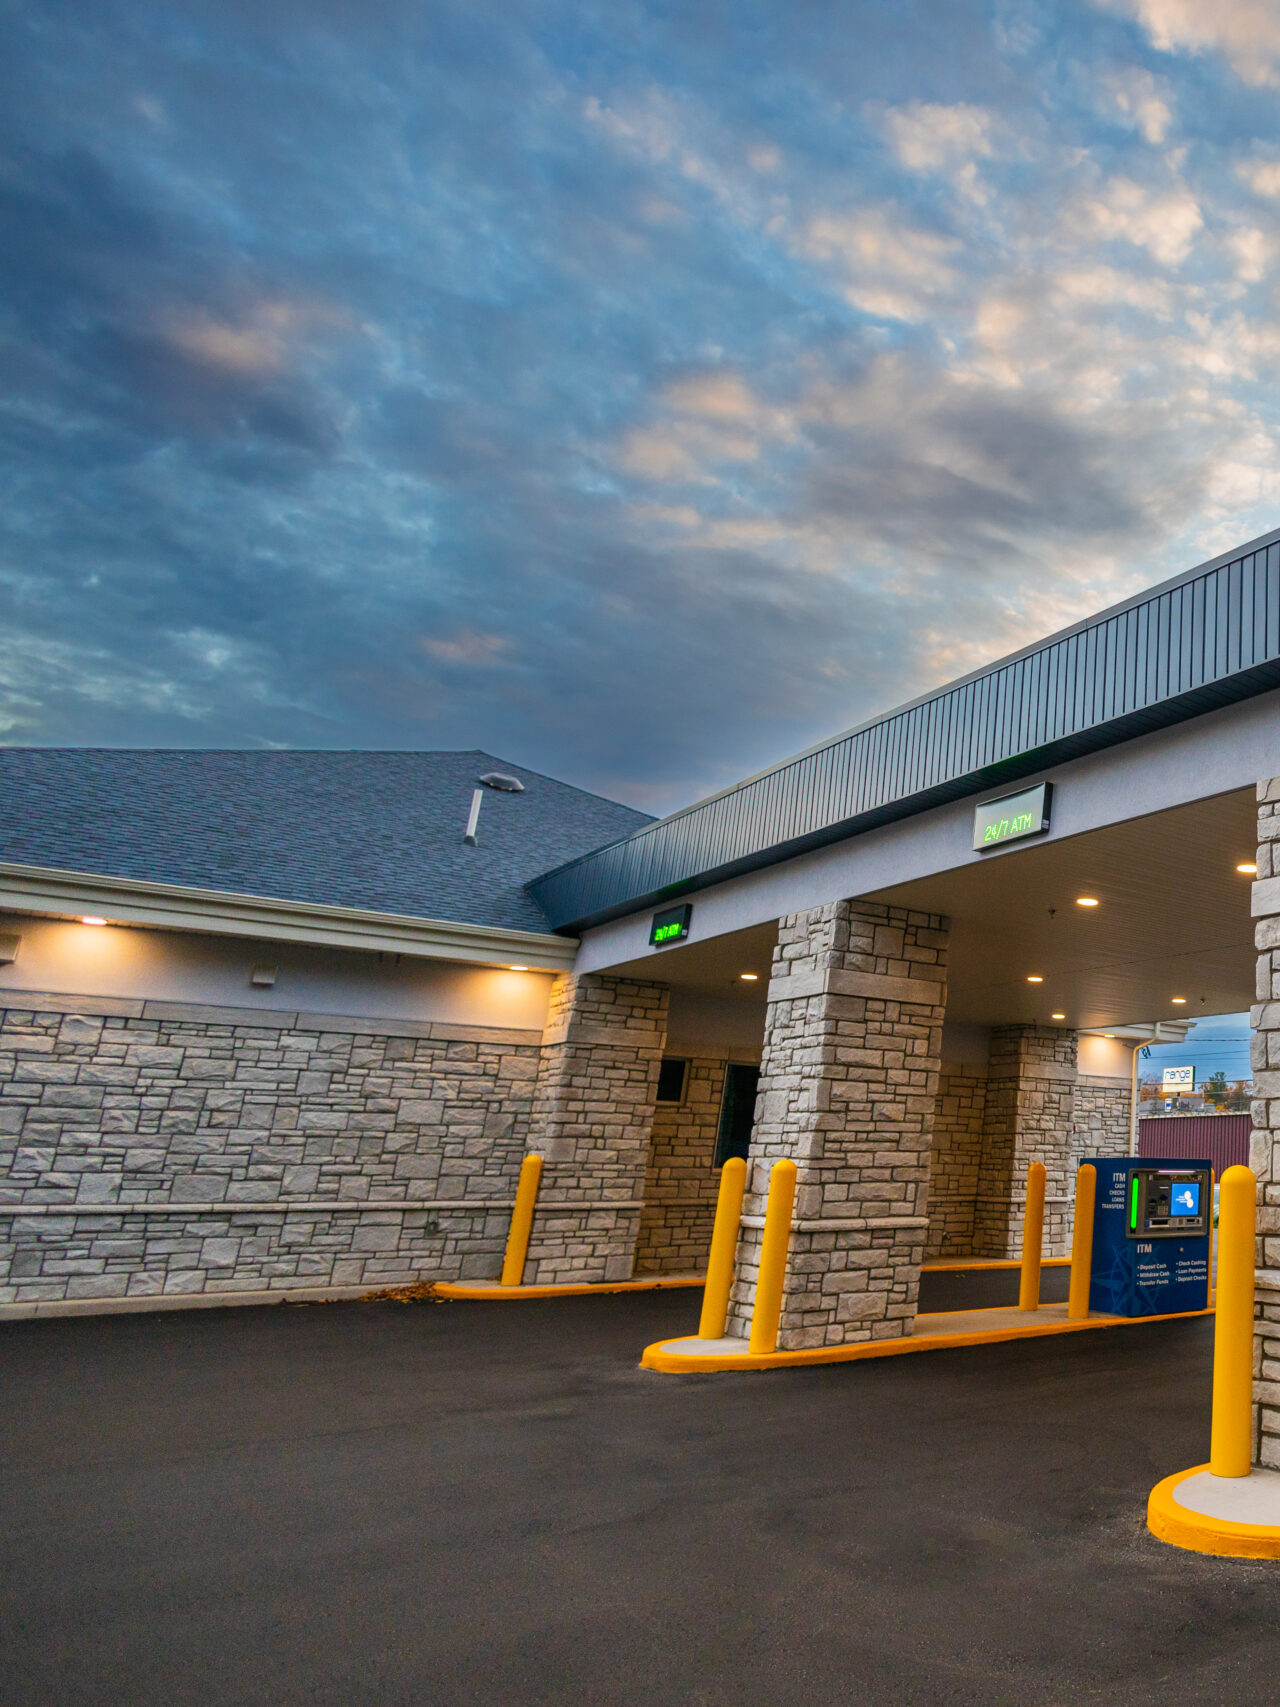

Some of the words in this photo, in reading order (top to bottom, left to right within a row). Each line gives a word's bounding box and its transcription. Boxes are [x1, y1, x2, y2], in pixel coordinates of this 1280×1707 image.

[984, 819, 1009, 842] 24/7
[1010, 812, 1033, 834] ATM
[1164, 1069, 1191, 1081] range
[1112, 1172, 1126, 1182] ITM
[1136, 1243, 1153, 1254] ITM
